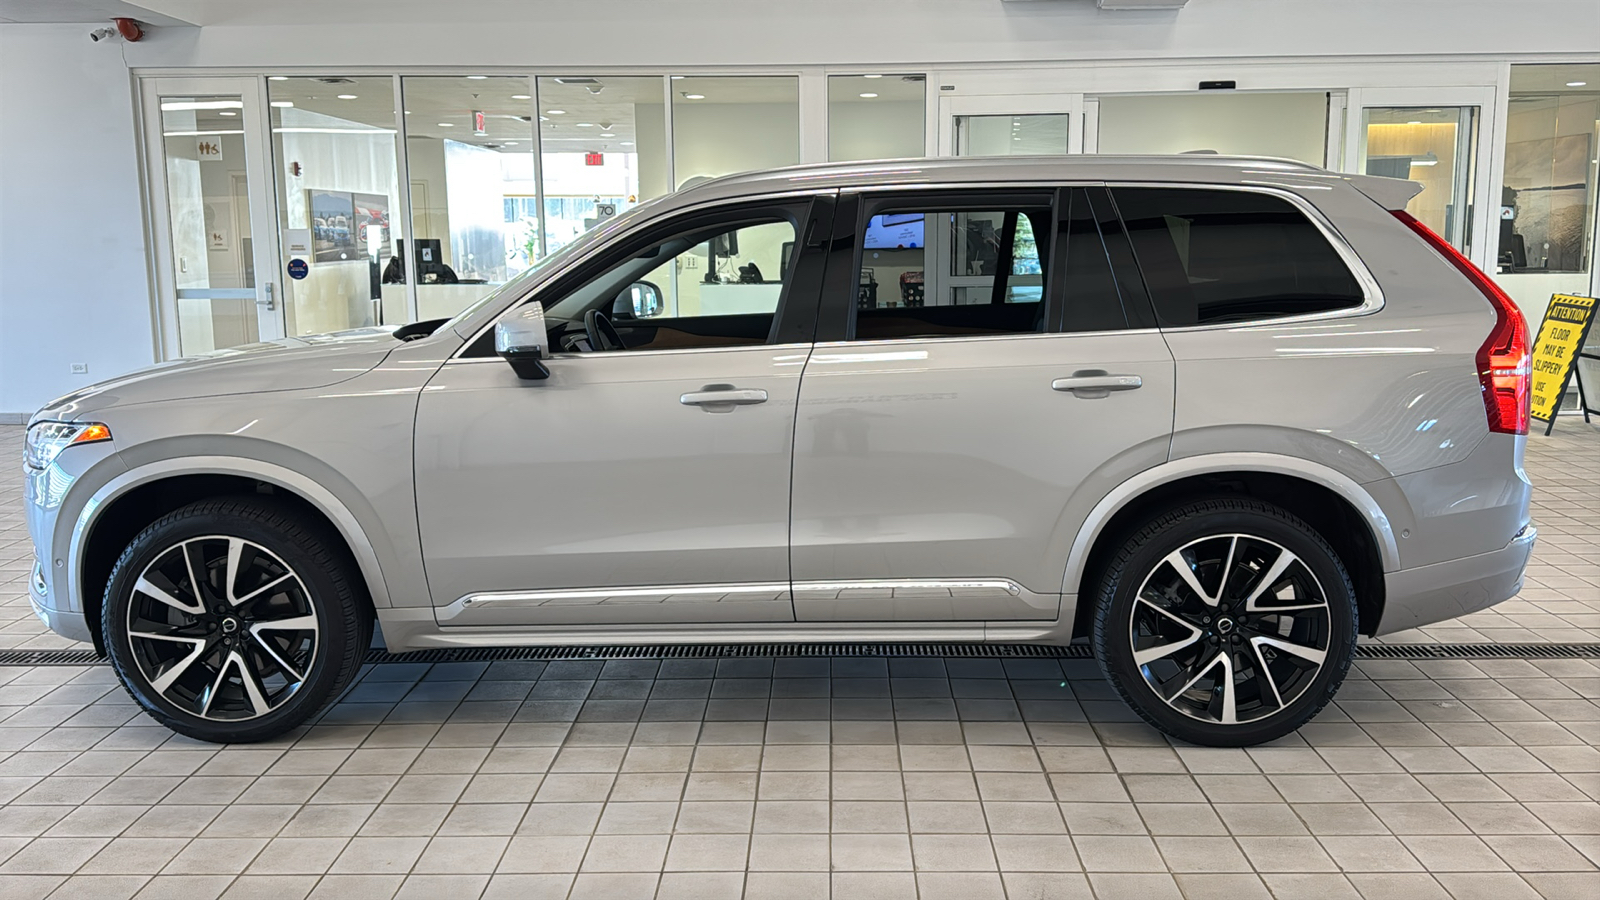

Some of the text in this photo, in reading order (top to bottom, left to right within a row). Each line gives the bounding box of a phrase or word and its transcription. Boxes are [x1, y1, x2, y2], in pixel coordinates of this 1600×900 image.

[588, 154, 602, 165] EXIT
[599, 206, 614, 216] 70
[1551, 306, 1586, 321] ATTENTION
[1550, 327, 1571, 341] FLOOR
[1543, 344, 1566, 358] MAY BE
[1533, 359, 1563, 376] SLIPPERY
[1535, 381, 1547, 392] USE
[1531, 394, 1547, 407] UTION
